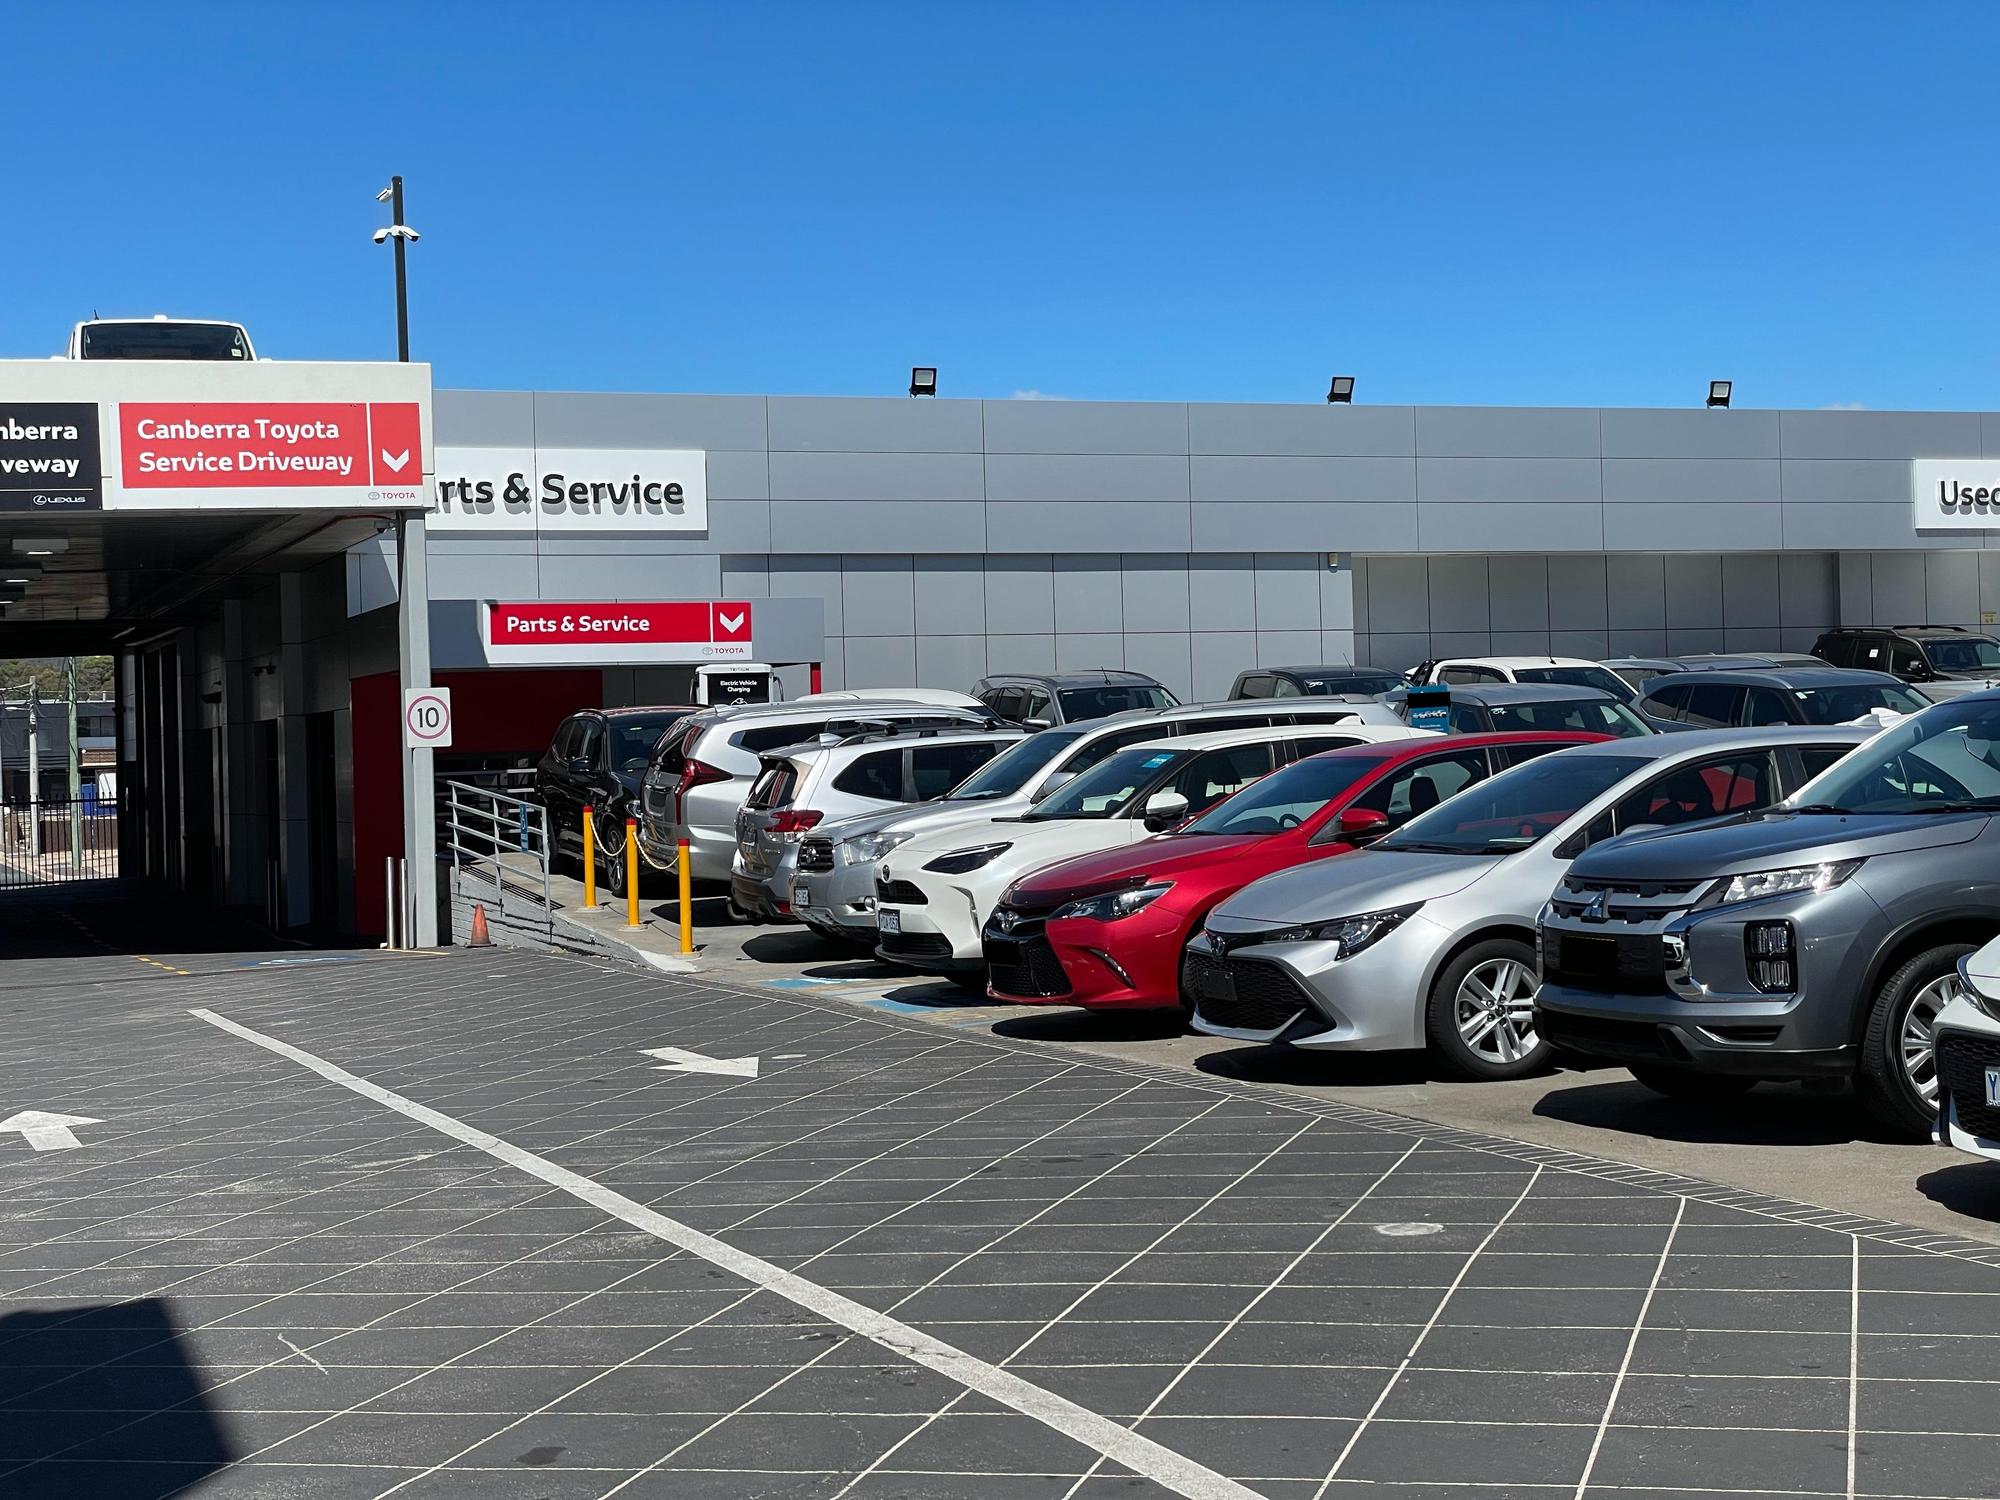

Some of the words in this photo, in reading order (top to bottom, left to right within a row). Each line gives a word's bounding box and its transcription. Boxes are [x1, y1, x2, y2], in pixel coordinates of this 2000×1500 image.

[137, 419, 251, 440] Canberra
[254, 419, 340, 444] Toyota
[139, 452, 233, 472] Service
[238, 451, 353, 476] Driveway
[381, 492, 416, 500] TOYOTA
[435, 477, 494, 504] rts
[503, 473, 530, 504] &
[541, 473, 684, 505] Service
[507, 616, 557, 633] Parts
[560, 615, 575, 632] &
[578, 615, 650, 632] Service
[714, 647, 744, 655] TOYOTA
[417, 707, 440, 728] 10
